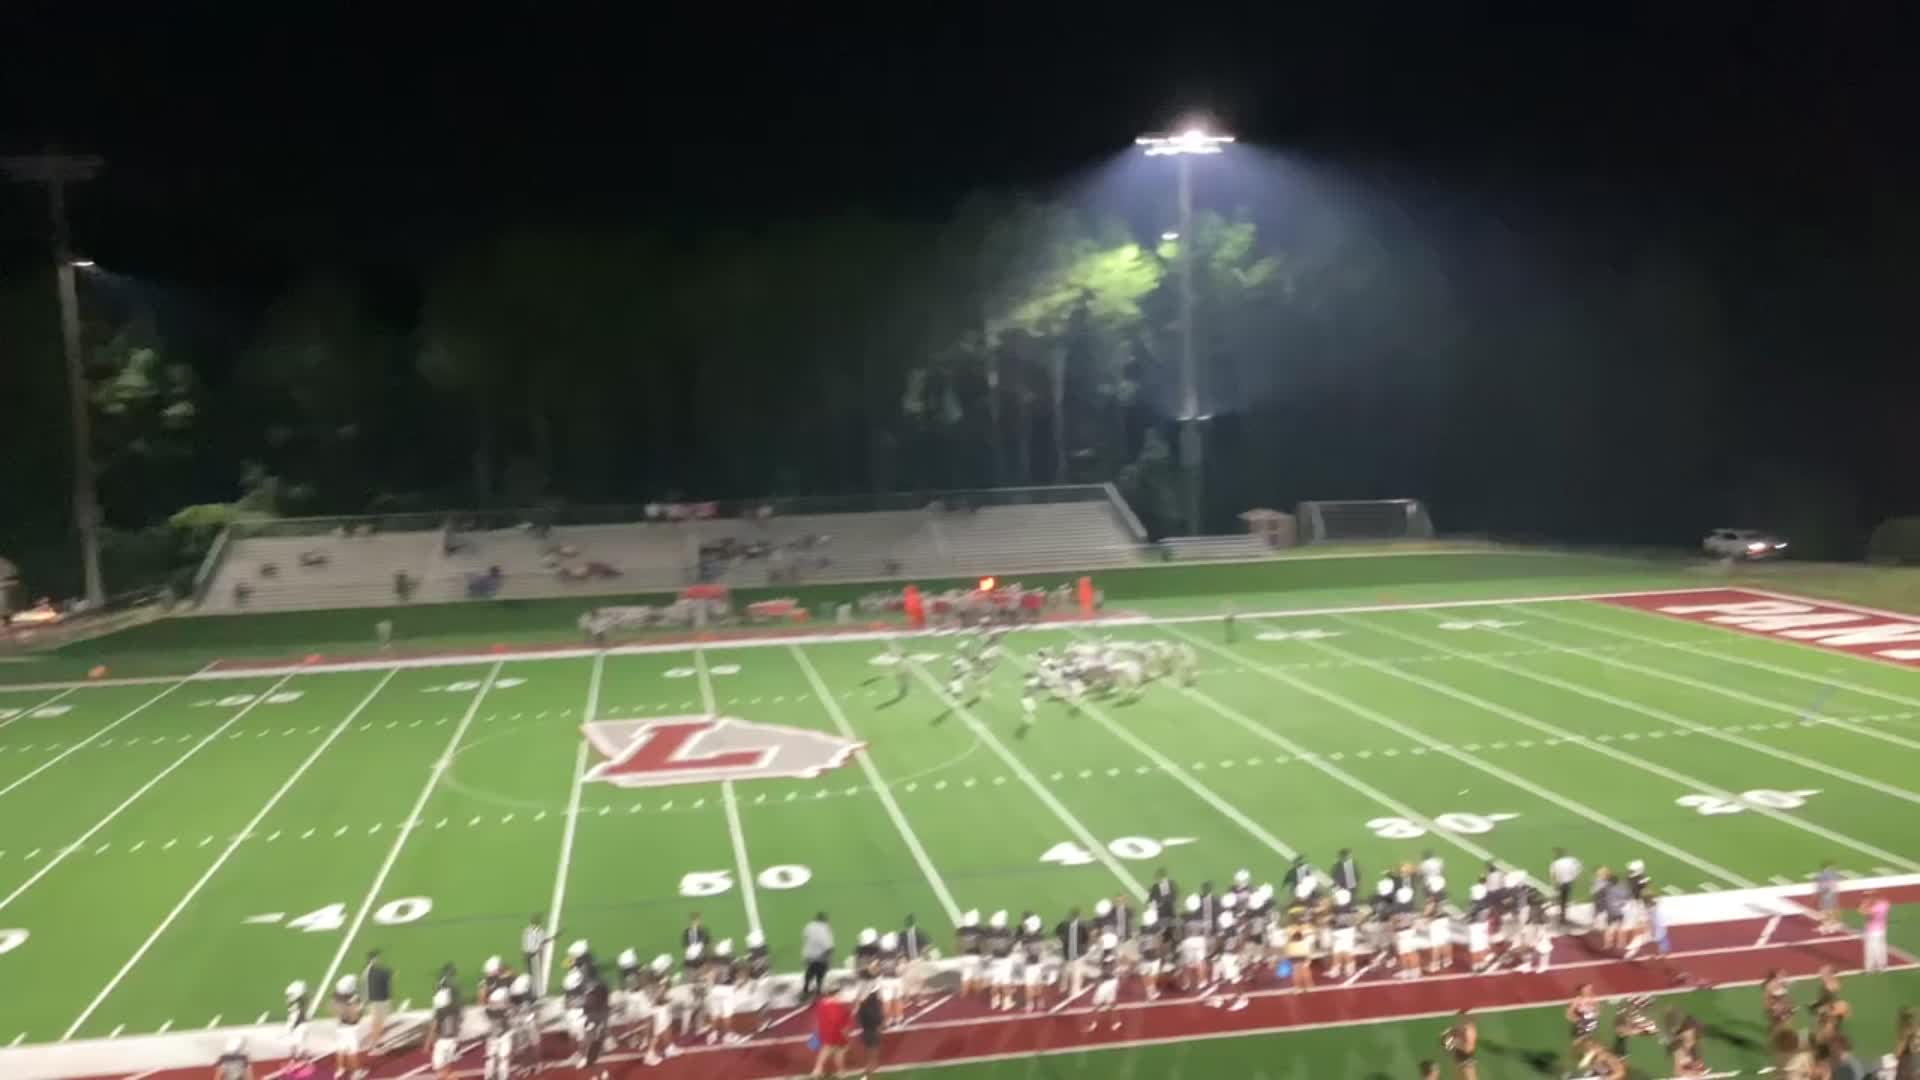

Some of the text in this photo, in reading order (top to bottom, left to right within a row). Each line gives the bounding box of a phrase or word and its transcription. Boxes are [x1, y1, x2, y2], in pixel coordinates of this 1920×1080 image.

[588, 718, 780, 781] L
[1039, 836, 1163, 865] 40
[679, 864, 811, 896] 50
[286, 896, 432, 932] 40
